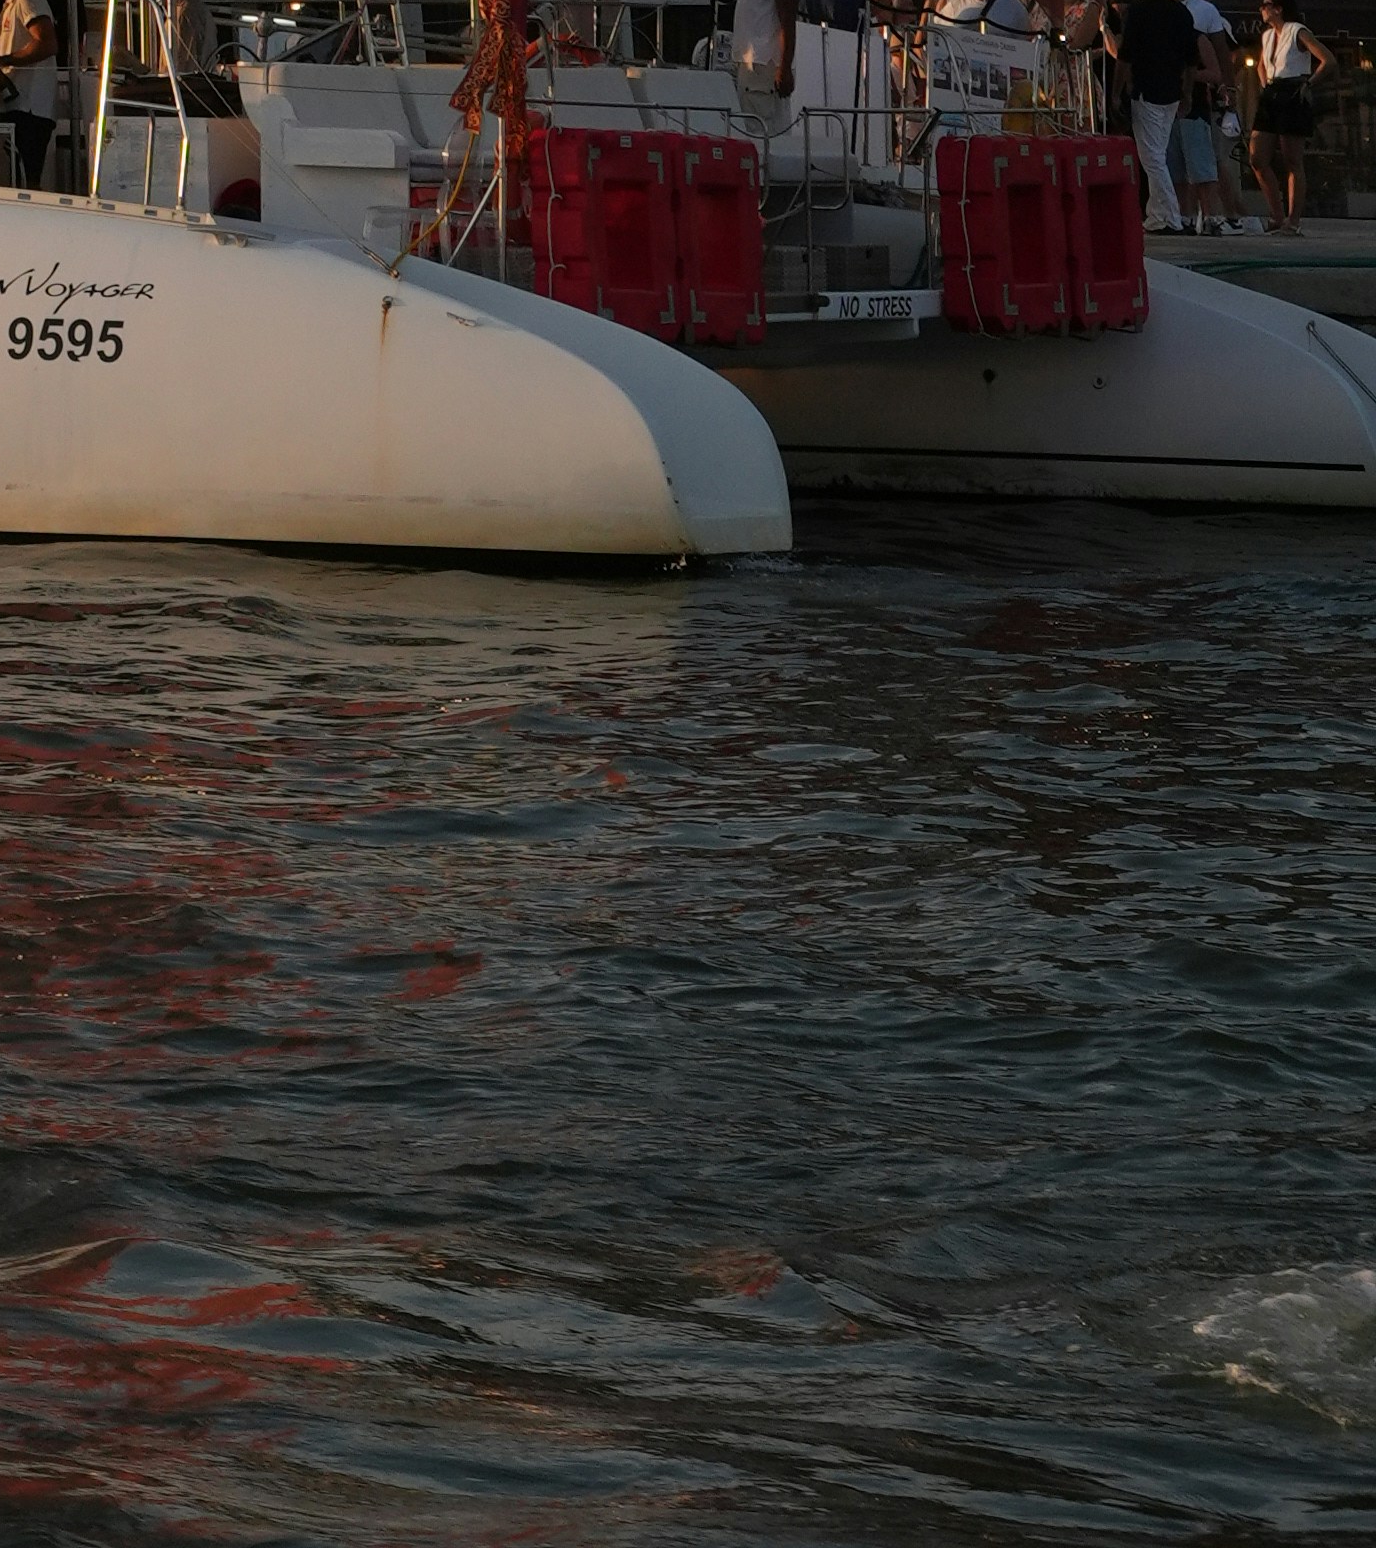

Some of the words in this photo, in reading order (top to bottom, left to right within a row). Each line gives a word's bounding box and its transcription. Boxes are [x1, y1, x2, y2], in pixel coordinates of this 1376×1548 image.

[839, 296, 860, 318] NO
[868, 296, 913, 317] STRESS
[7, 317, 125, 363] 9595
